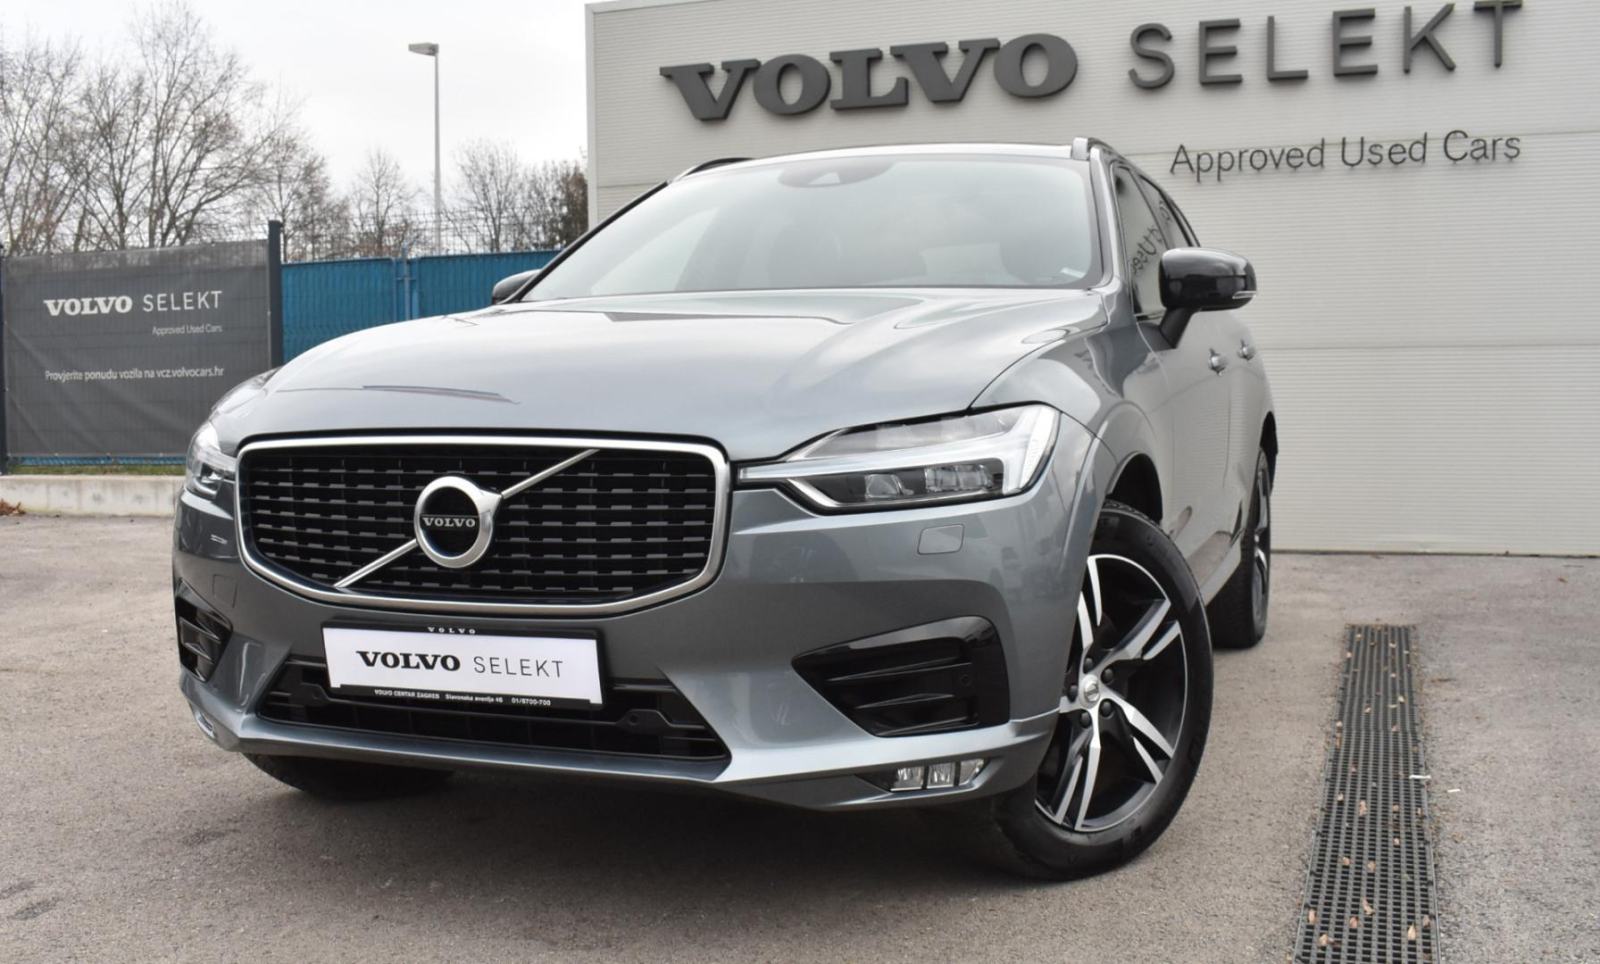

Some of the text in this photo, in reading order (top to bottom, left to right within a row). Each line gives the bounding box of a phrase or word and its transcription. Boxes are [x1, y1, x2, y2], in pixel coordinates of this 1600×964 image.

[660, 0, 1523, 121] VOLVO SELEKT
[1169, 130, 1521, 183] Approved Used Cars
[44, 290, 223, 317] VOLVO SELEKT
[152, 323, 223, 336] Approved Used Cars
[45, 365, 225, 383] Provjerite ponudu vozila na vcz.volvocars.hr
[422, 517, 476, 528] VOLVO
[427, 626, 477, 635] VOLVO
[356, 650, 563, 678] VOLVO SELEKT
[374, 689, 393, 697] VOLVO
